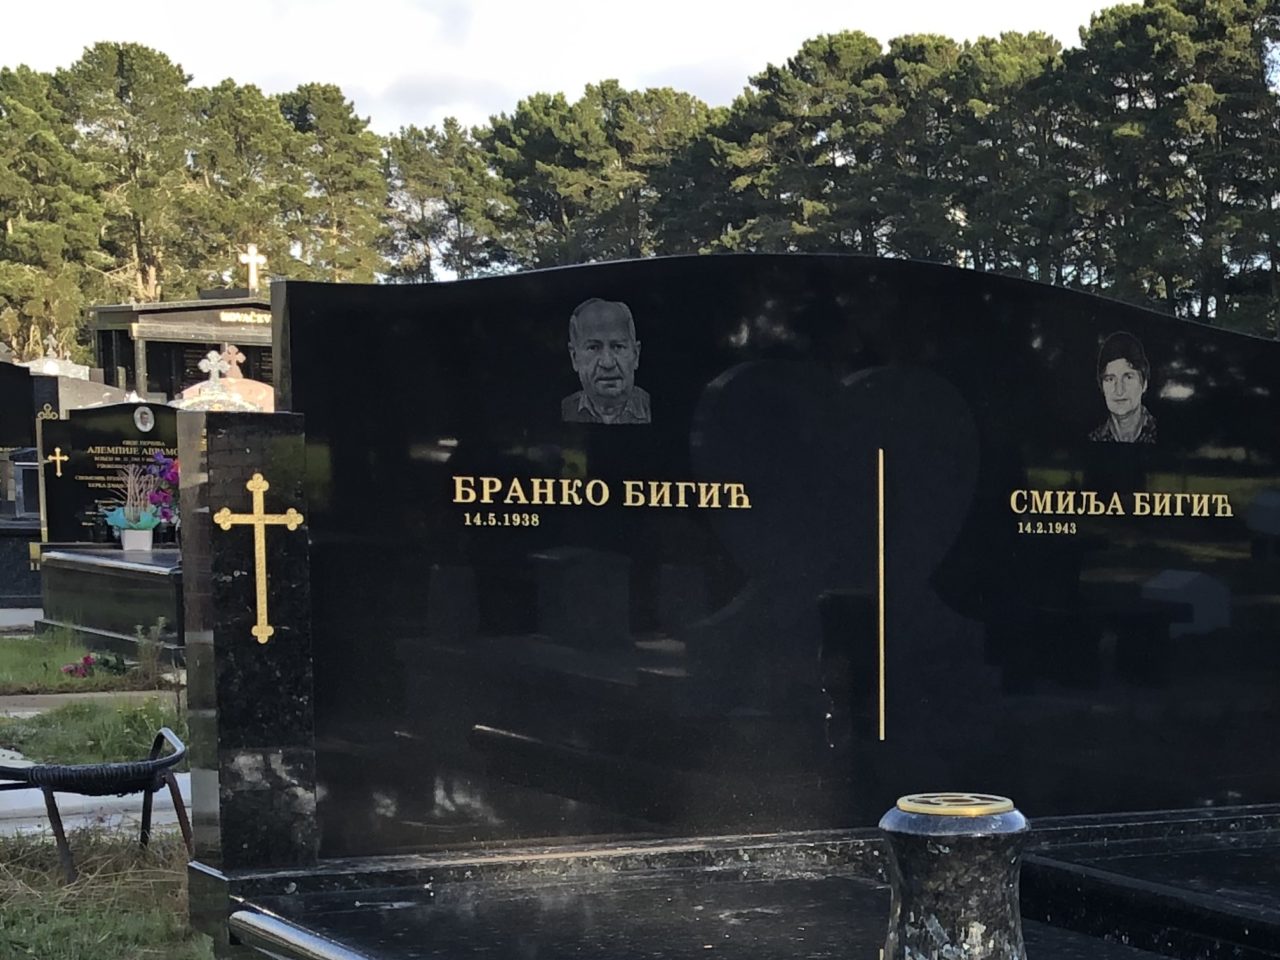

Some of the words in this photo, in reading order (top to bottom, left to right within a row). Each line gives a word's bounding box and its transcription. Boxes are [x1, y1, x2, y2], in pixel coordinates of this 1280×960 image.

[452, 476, 610, 506] БРАНКО
[622, 480, 752, 509] БИГИЋ
[1009, 489, 1126, 516] СМИЉА
[1132, 492, 1234, 517] БИГИЋ
[464, 513, 540, 527] 14.5.1938
[1018, 522, 1077, 534] 14.2.1943
